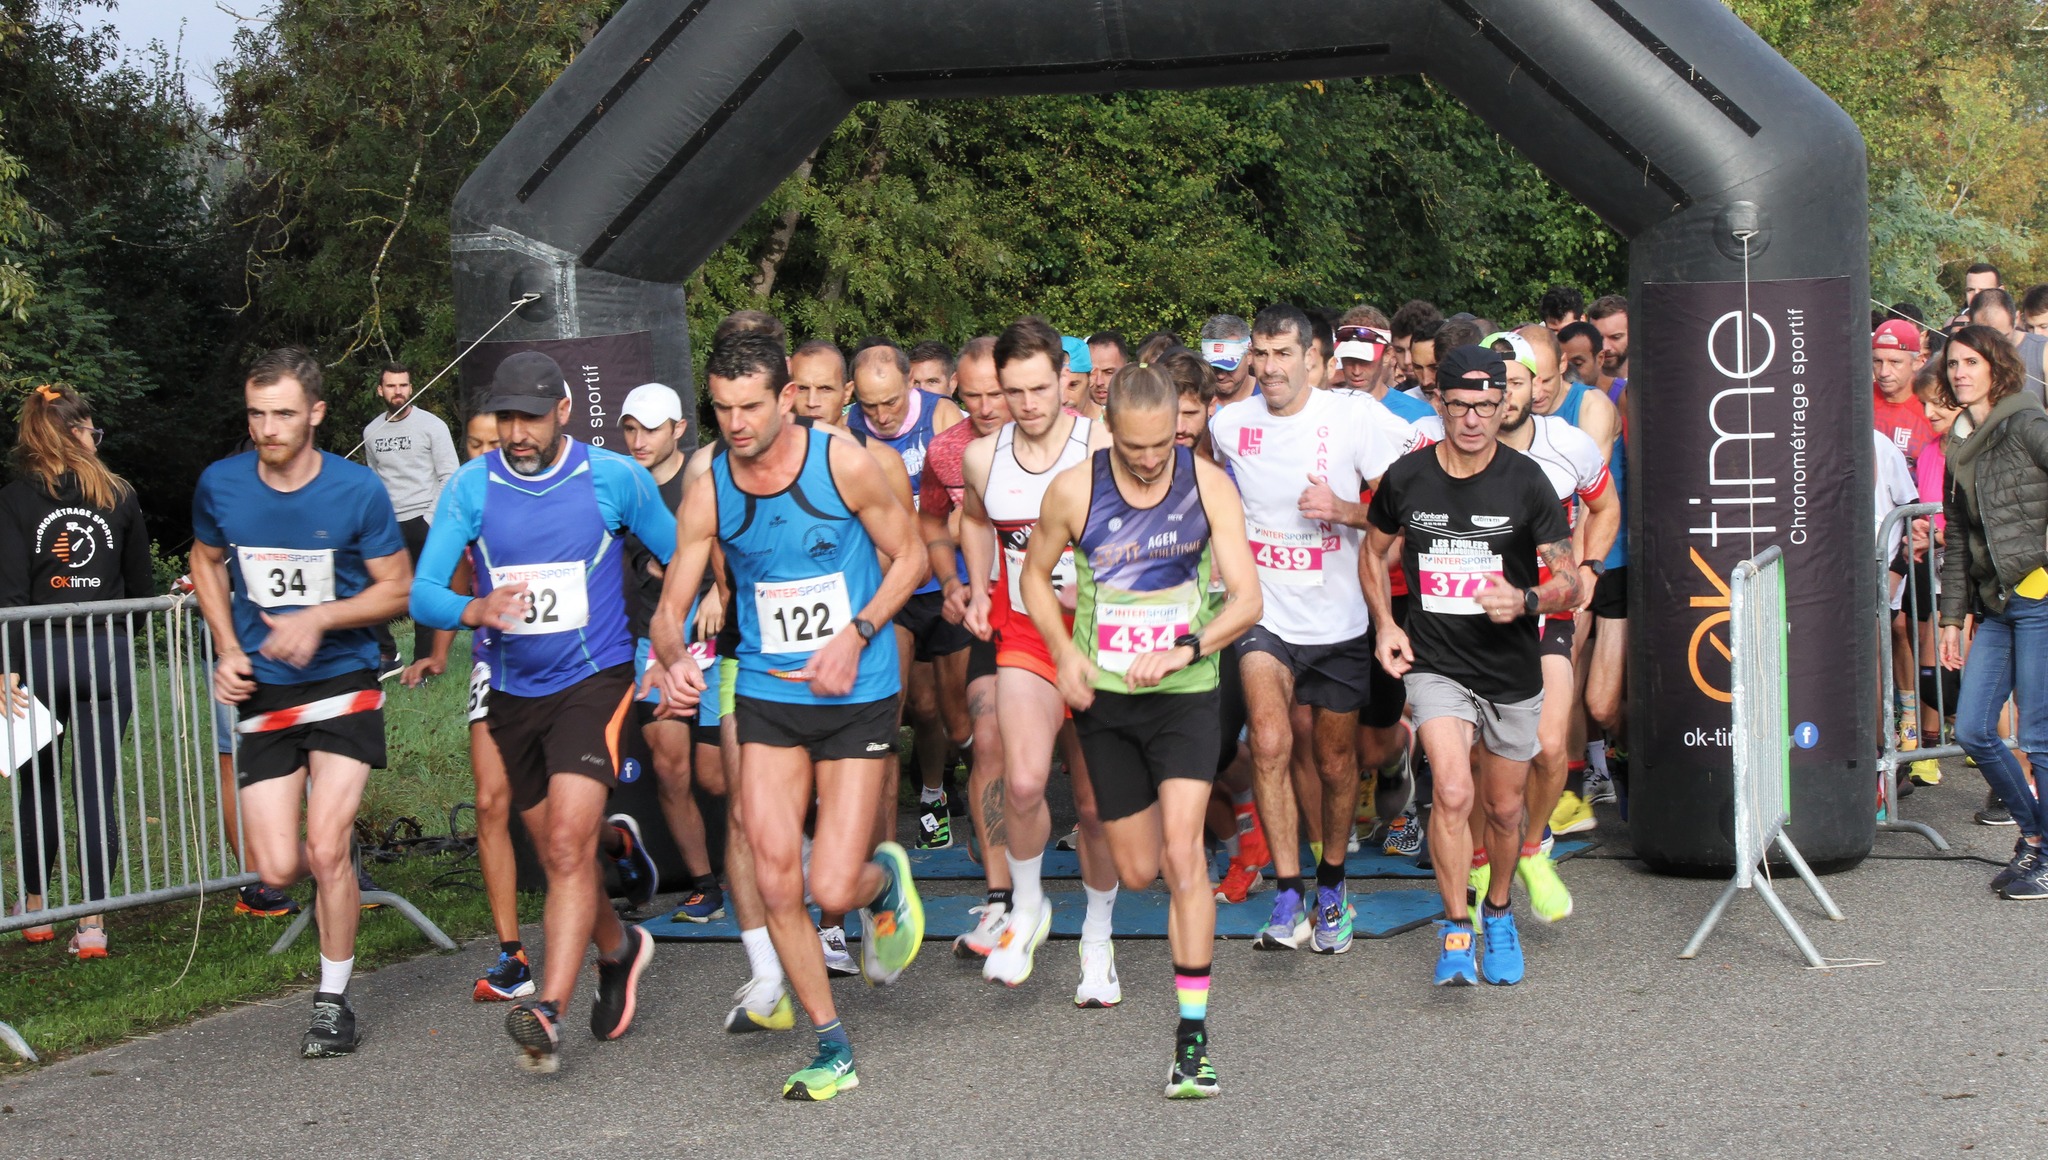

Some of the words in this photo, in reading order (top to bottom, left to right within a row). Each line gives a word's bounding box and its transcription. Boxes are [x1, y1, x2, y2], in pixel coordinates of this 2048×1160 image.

[1787, 308, 1808, 375] sportif
[582, 365, 606, 428] sportif
[1790, 382, 1809, 545] Chronométrage
[35, 507, 92, 554] CHRONOMÉTRAGE
[92, 514, 114, 550] SPORTIF
[1147, 531, 1177, 550] AGEN
[1260, 529, 1313, 541] INTERSPORT
[1432, 538, 1449, 549] LES
[253, 553, 326, 563] INTERSPORT
[1256, 544, 1312, 570] 439
[1433, 556, 1493, 566] INTERSPORT
[268, 567, 307, 598] 34
[506, 567, 577, 582] INTERSPORT
[1430, 572, 1488, 597] 377
[766, 580, 837, 599] INTERSPORT
[773, 602, 834, 642] 122
[1114, 606, 1179, 619] INTERSPORT
[1109, 624, 1176, 653] 434
